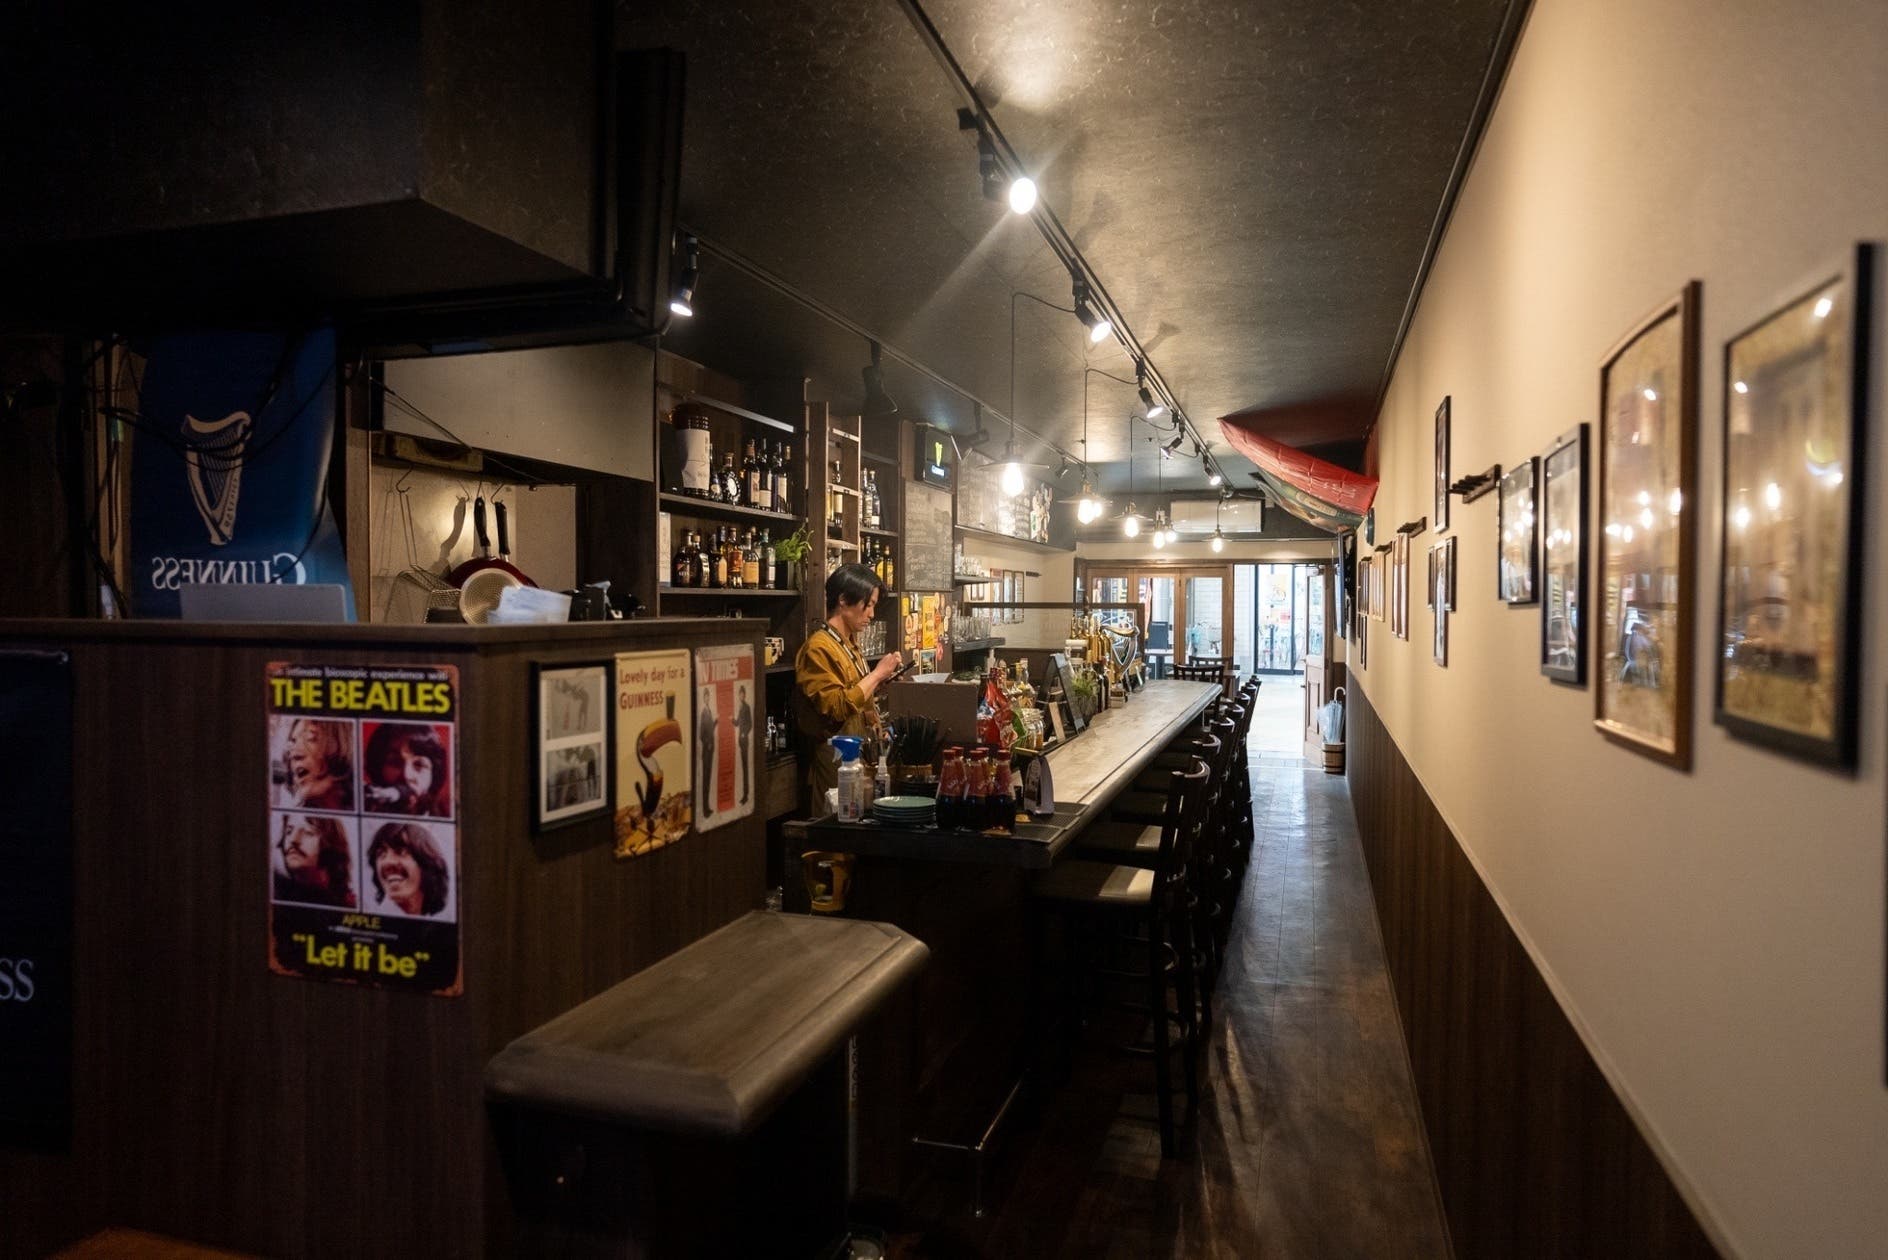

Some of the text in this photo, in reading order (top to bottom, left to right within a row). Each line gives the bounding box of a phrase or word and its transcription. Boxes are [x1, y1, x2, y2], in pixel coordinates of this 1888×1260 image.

[620, 669, 648, 684] Lovely
[652, 668, 665, 681] day
[667, 665, 678, 678] for
[270, 679, 451, 714] THE BEATLES
[621, 690, 663, 709] GUINNESS
[342, 915, 380, 929] APPLE
[354, 943, 372, 970] it
